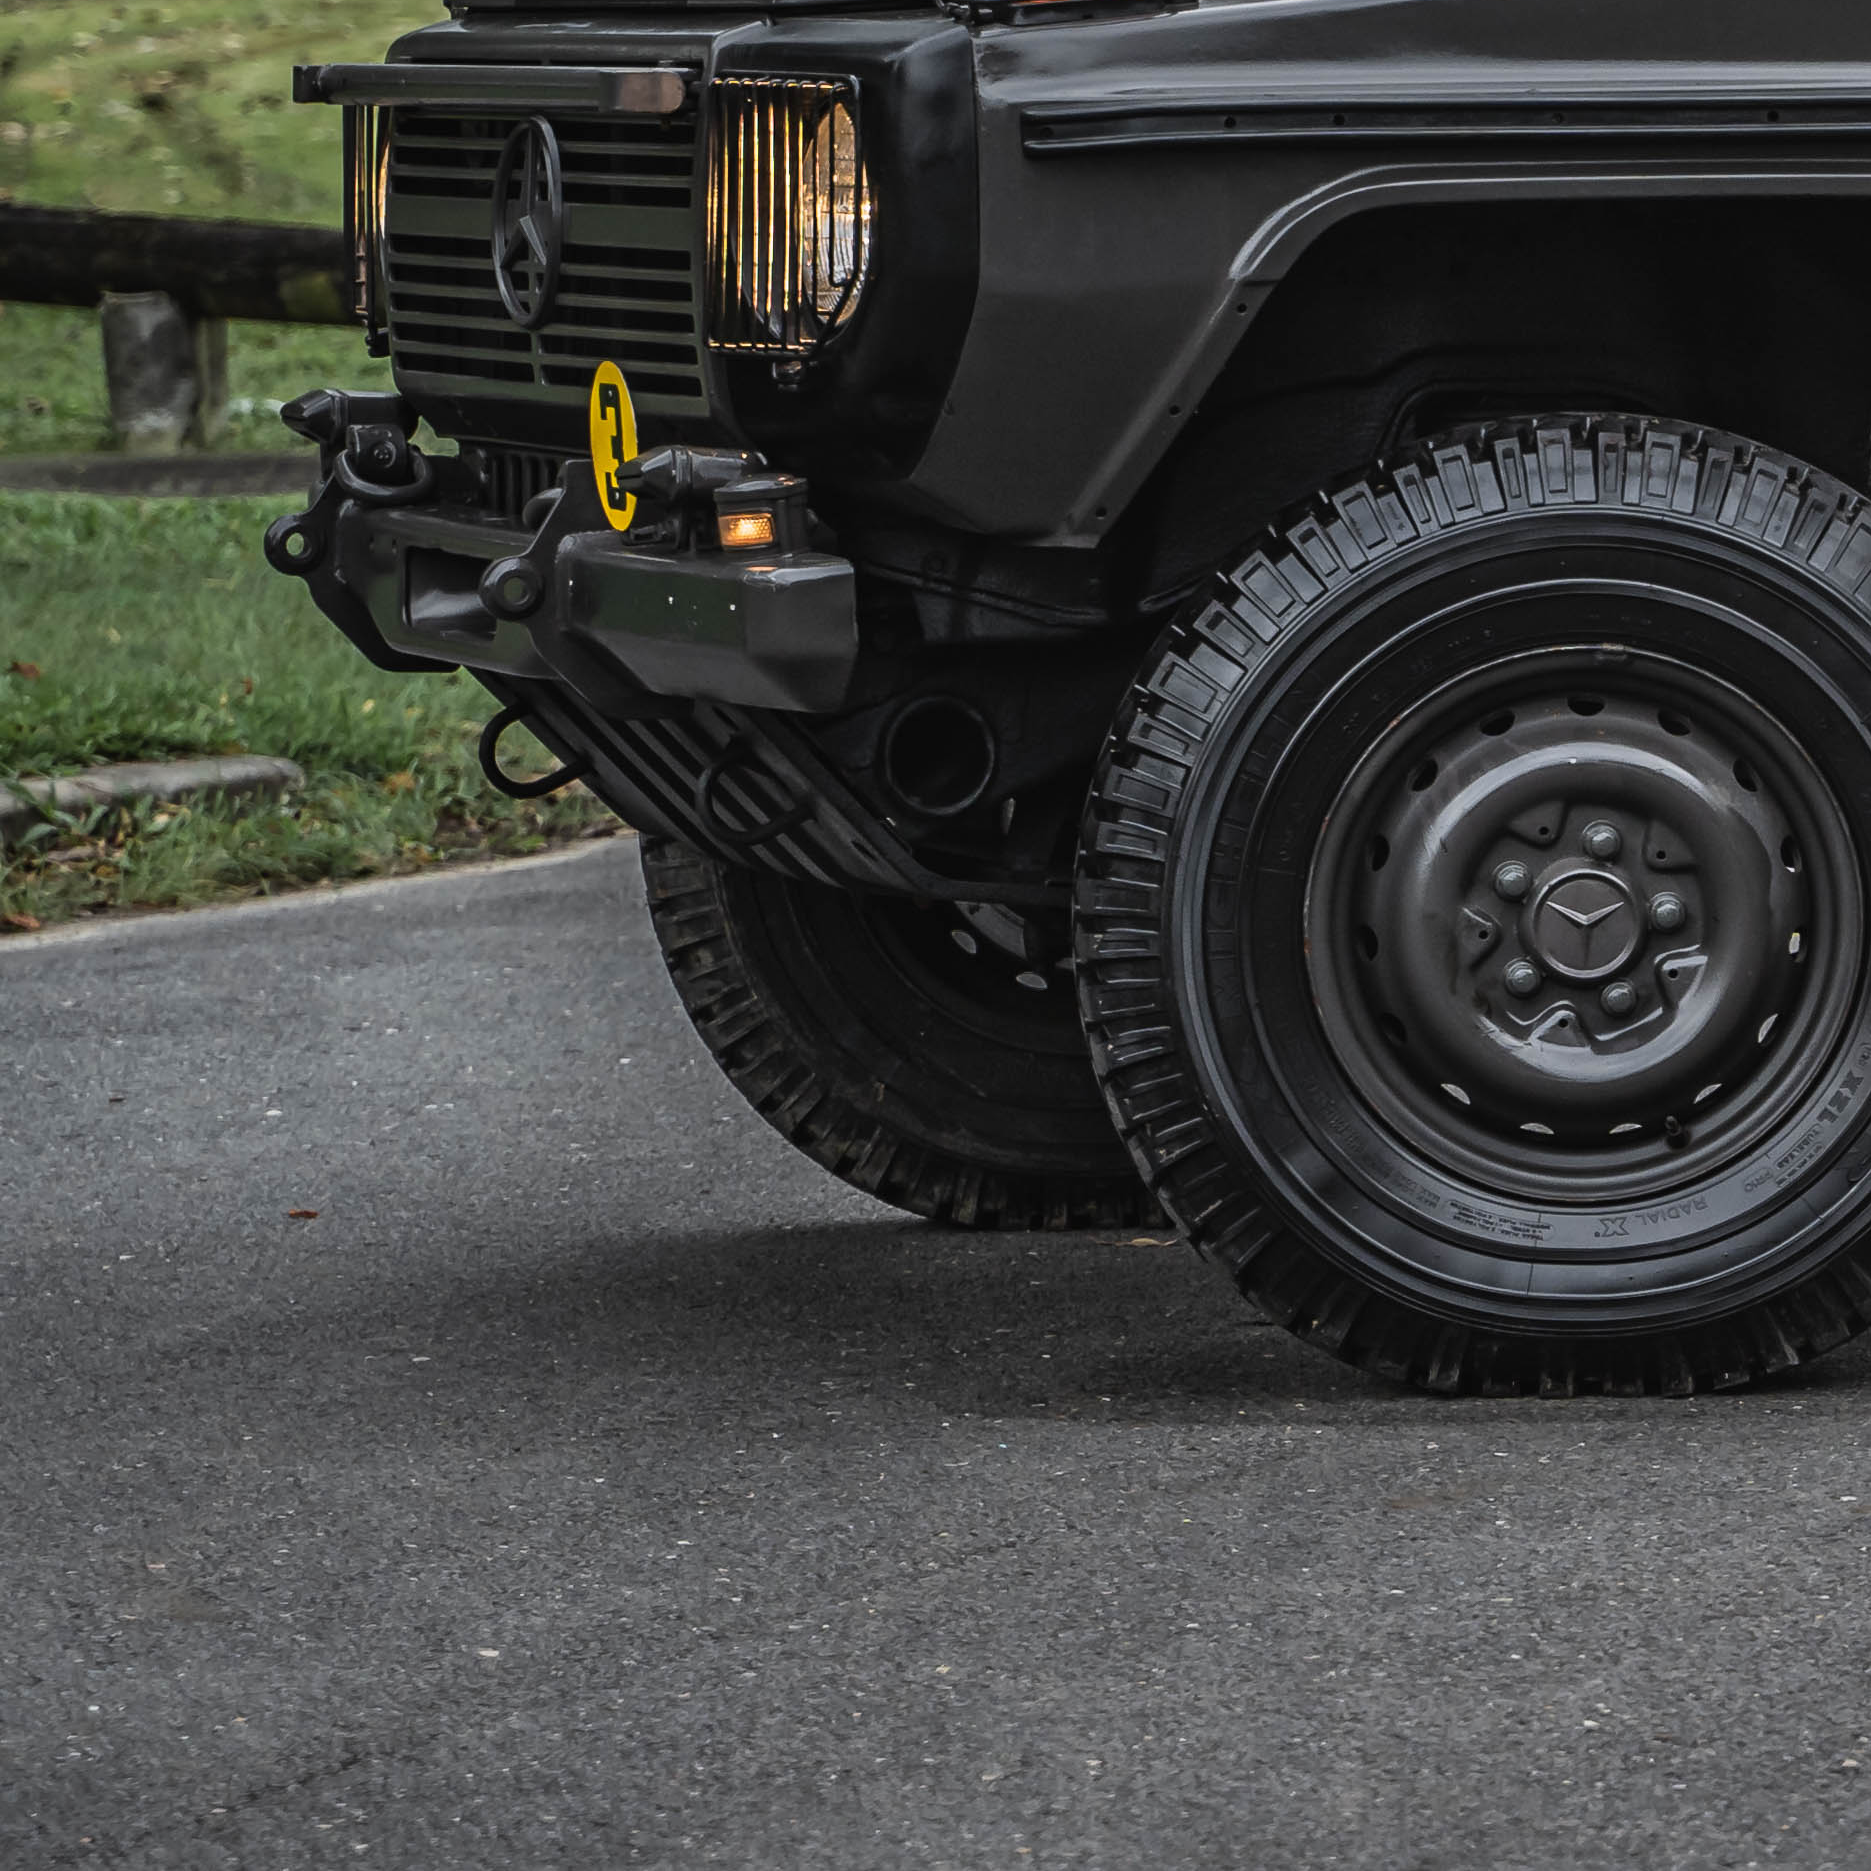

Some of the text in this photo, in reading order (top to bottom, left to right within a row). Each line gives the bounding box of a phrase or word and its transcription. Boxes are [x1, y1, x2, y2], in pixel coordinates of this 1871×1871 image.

[598, 382, 627, 511] 3
[1818, 1071, 1864, 1125] XZL
[1635, 1196, 1708, 1226] RADIAL
